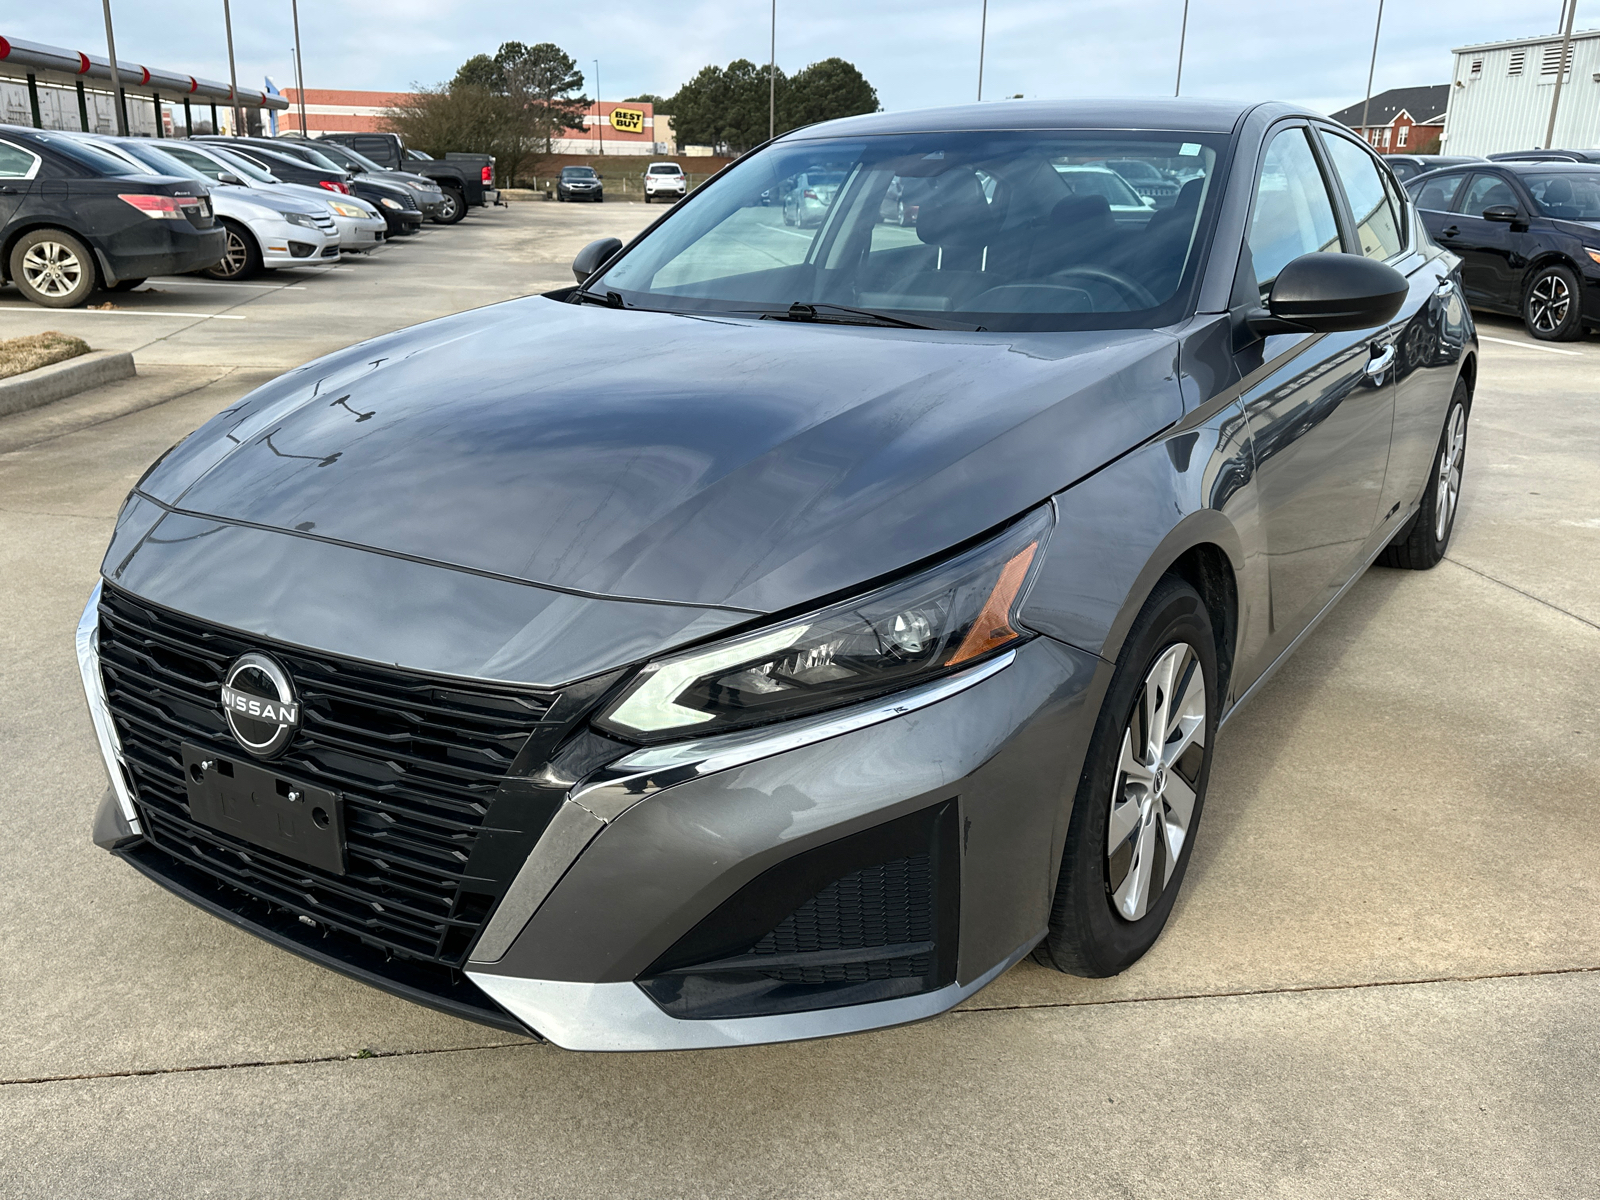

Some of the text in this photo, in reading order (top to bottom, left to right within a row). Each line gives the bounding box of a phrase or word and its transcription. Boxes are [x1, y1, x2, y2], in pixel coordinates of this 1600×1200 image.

[615, 111, 641, 121] BEST
[616, 119, 639, 128] BUY
[222, 688, 295, 723] NISSAN
